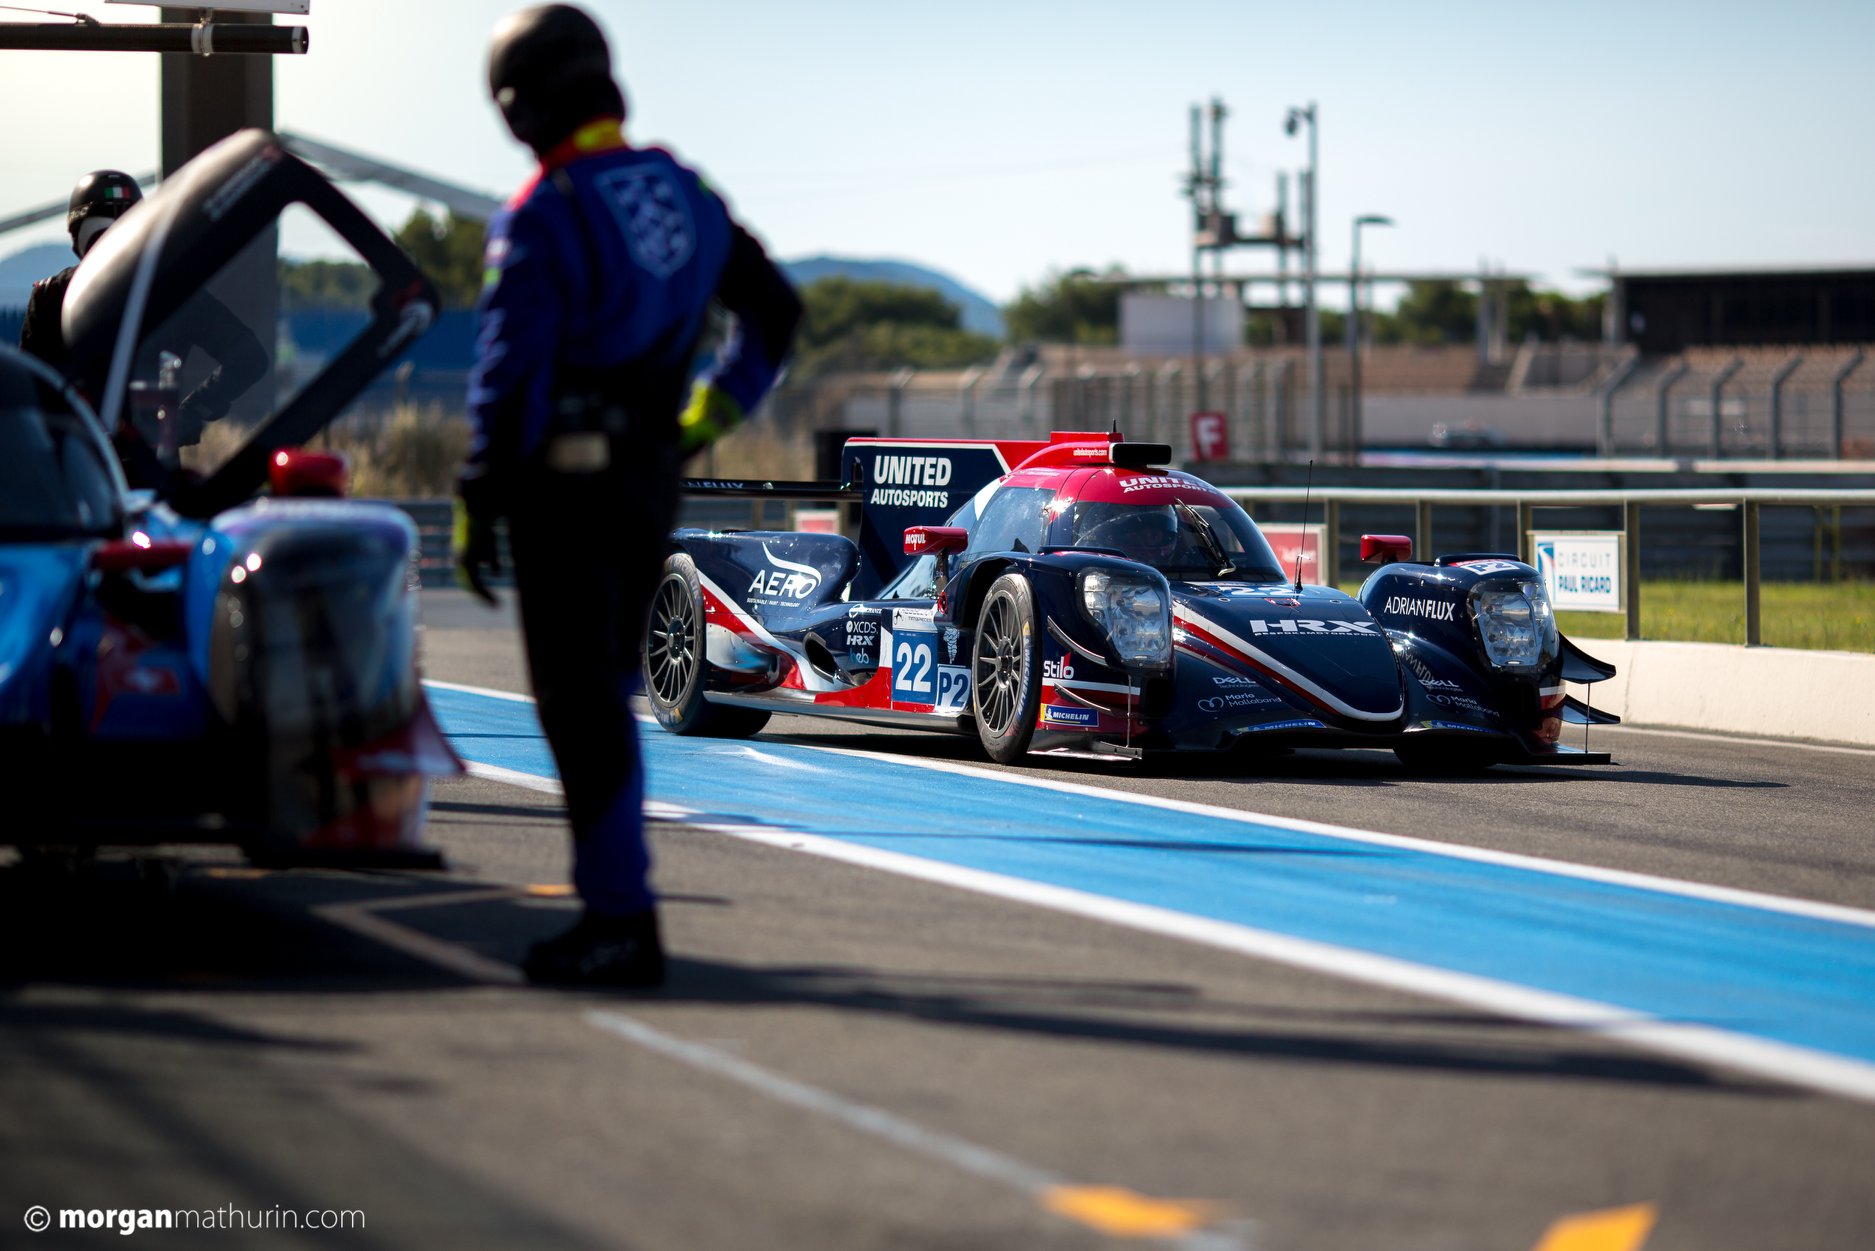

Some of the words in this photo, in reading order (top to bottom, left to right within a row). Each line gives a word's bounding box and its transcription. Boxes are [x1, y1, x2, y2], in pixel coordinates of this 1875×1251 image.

[873, 455, 952, 486] UNITED
[870, 488, 949, 508] AUTOSPORTS
[905, 532, 926, 551] MOTUL
[1558, 552, 1611, 568] CIRCUIT
[748, 569, 817, 599] AERO
[1559, 576, 1578, 593] PAUL
[1581, 576, 1611, 593] RICARD
[1249, 619, 1377, 633] HRX
[846, 635, 875, 646] HRX
[896, 642, 931, 692] 22
[1043, 655, 1075, 680] Stilo
[937, 672, 968, 707] P2
[1017, 648, 1031, 716] MICHELIN
[1212, 676, 1257, 684] DELL
[1053, 711, 1089, 721] MICHELIN
